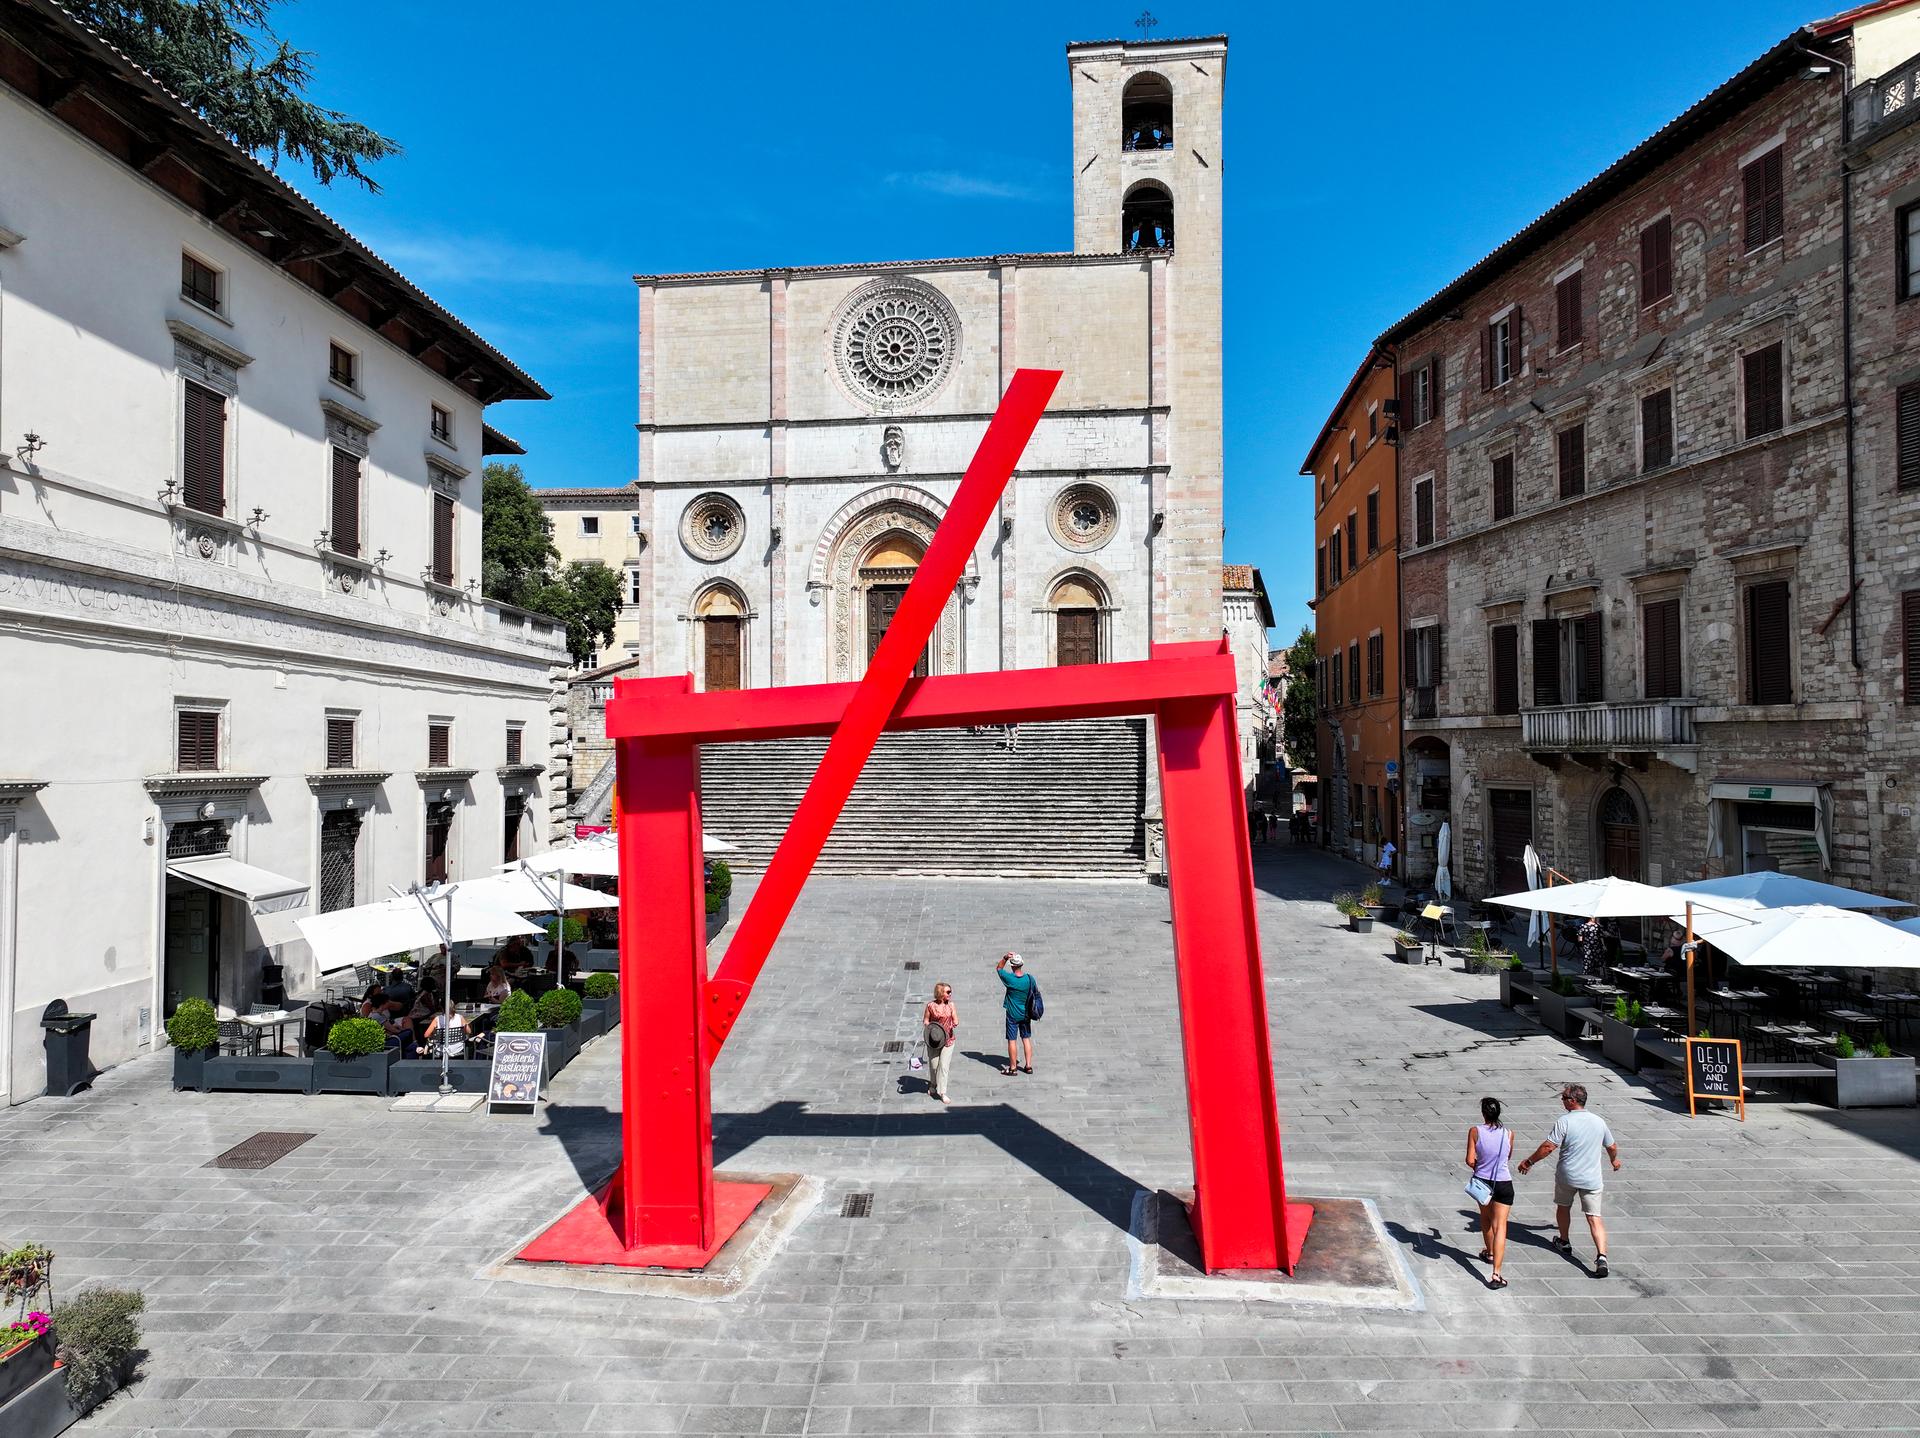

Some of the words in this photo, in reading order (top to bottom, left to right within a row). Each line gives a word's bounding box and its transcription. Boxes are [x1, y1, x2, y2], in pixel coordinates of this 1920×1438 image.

[502, 1053, 535, 1064] gelateria
[1697, 1046, 1730, 1064] DELI
[497, 1063, 538, 1073] pasticceria
[1702, 1063, 1728, 1074] FOOD
[499, 1073, 532, 1083] aperitivi
[1705, 1073, 1724, 1082] AND
[1703, 1082, 1729, 1092] WINE
